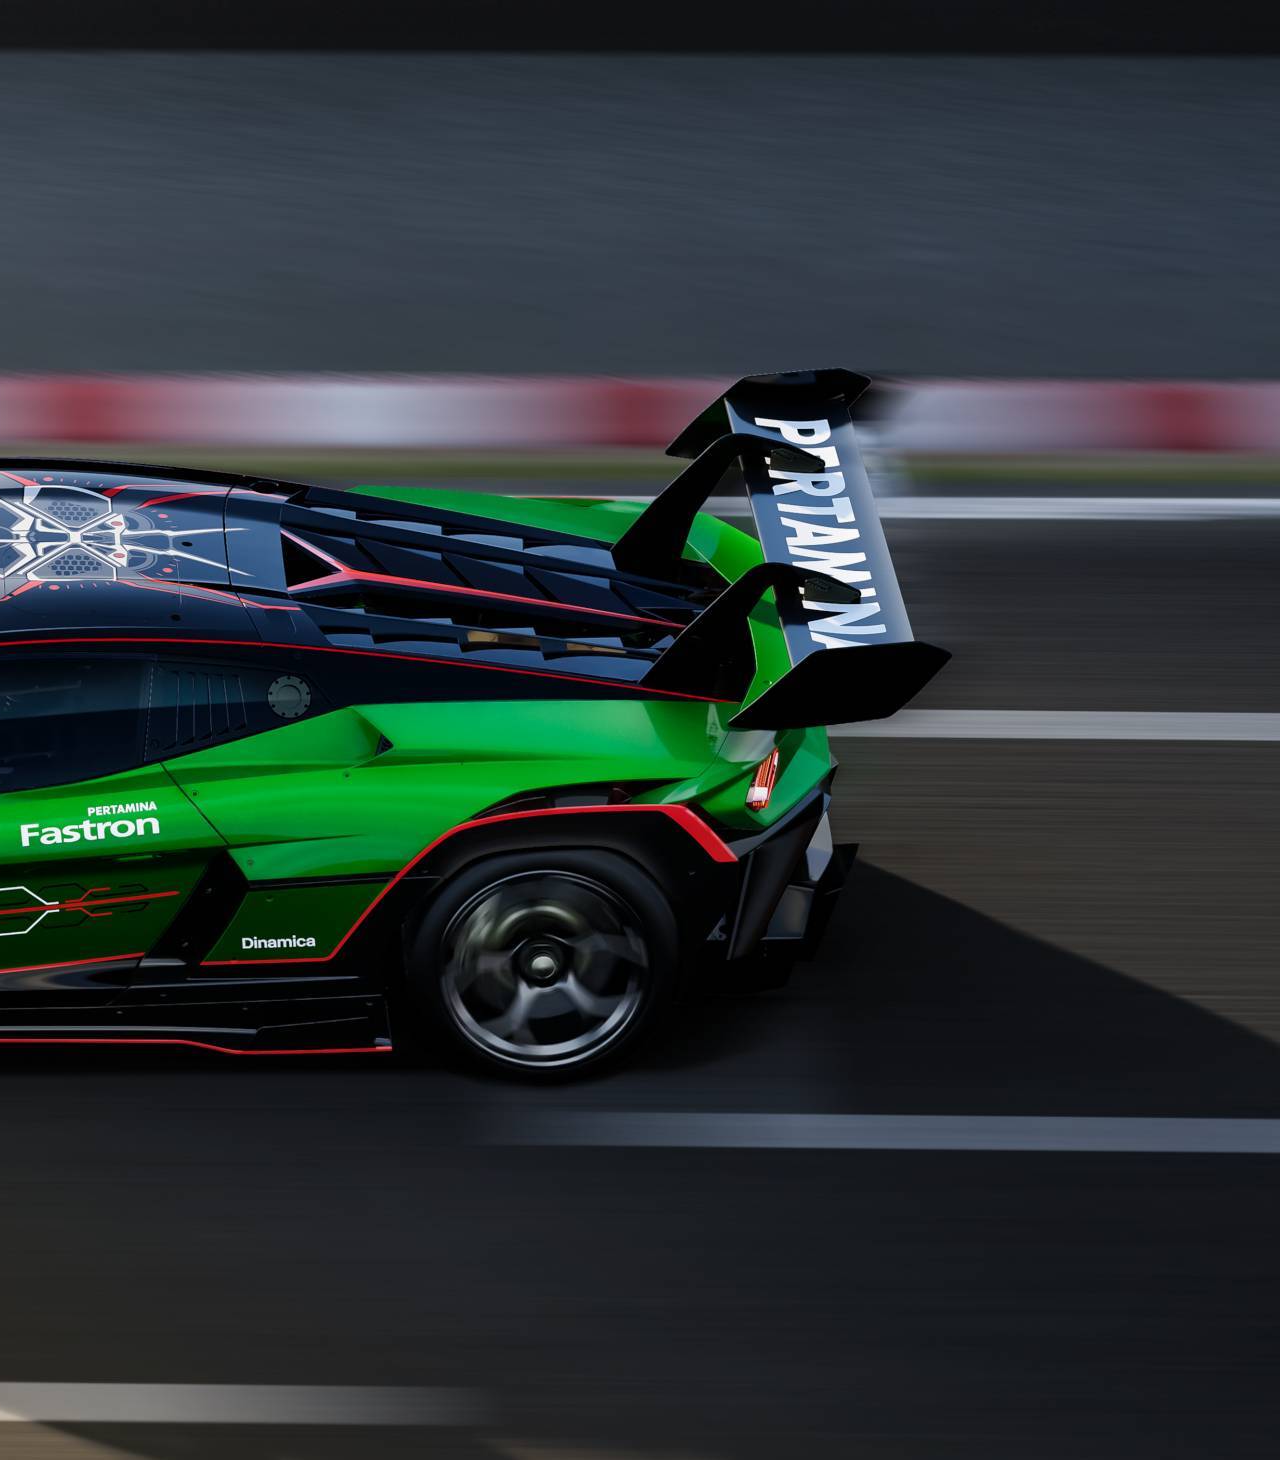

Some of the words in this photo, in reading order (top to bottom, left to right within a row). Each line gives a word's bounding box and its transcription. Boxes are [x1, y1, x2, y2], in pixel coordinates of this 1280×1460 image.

[754, 417, 887, 649] PRTAMN
[87, 800, 158, 817] PERTAMINA
[20, 817, 160, 847] Fastron
[241, 934, 316, 949] Dinamica
